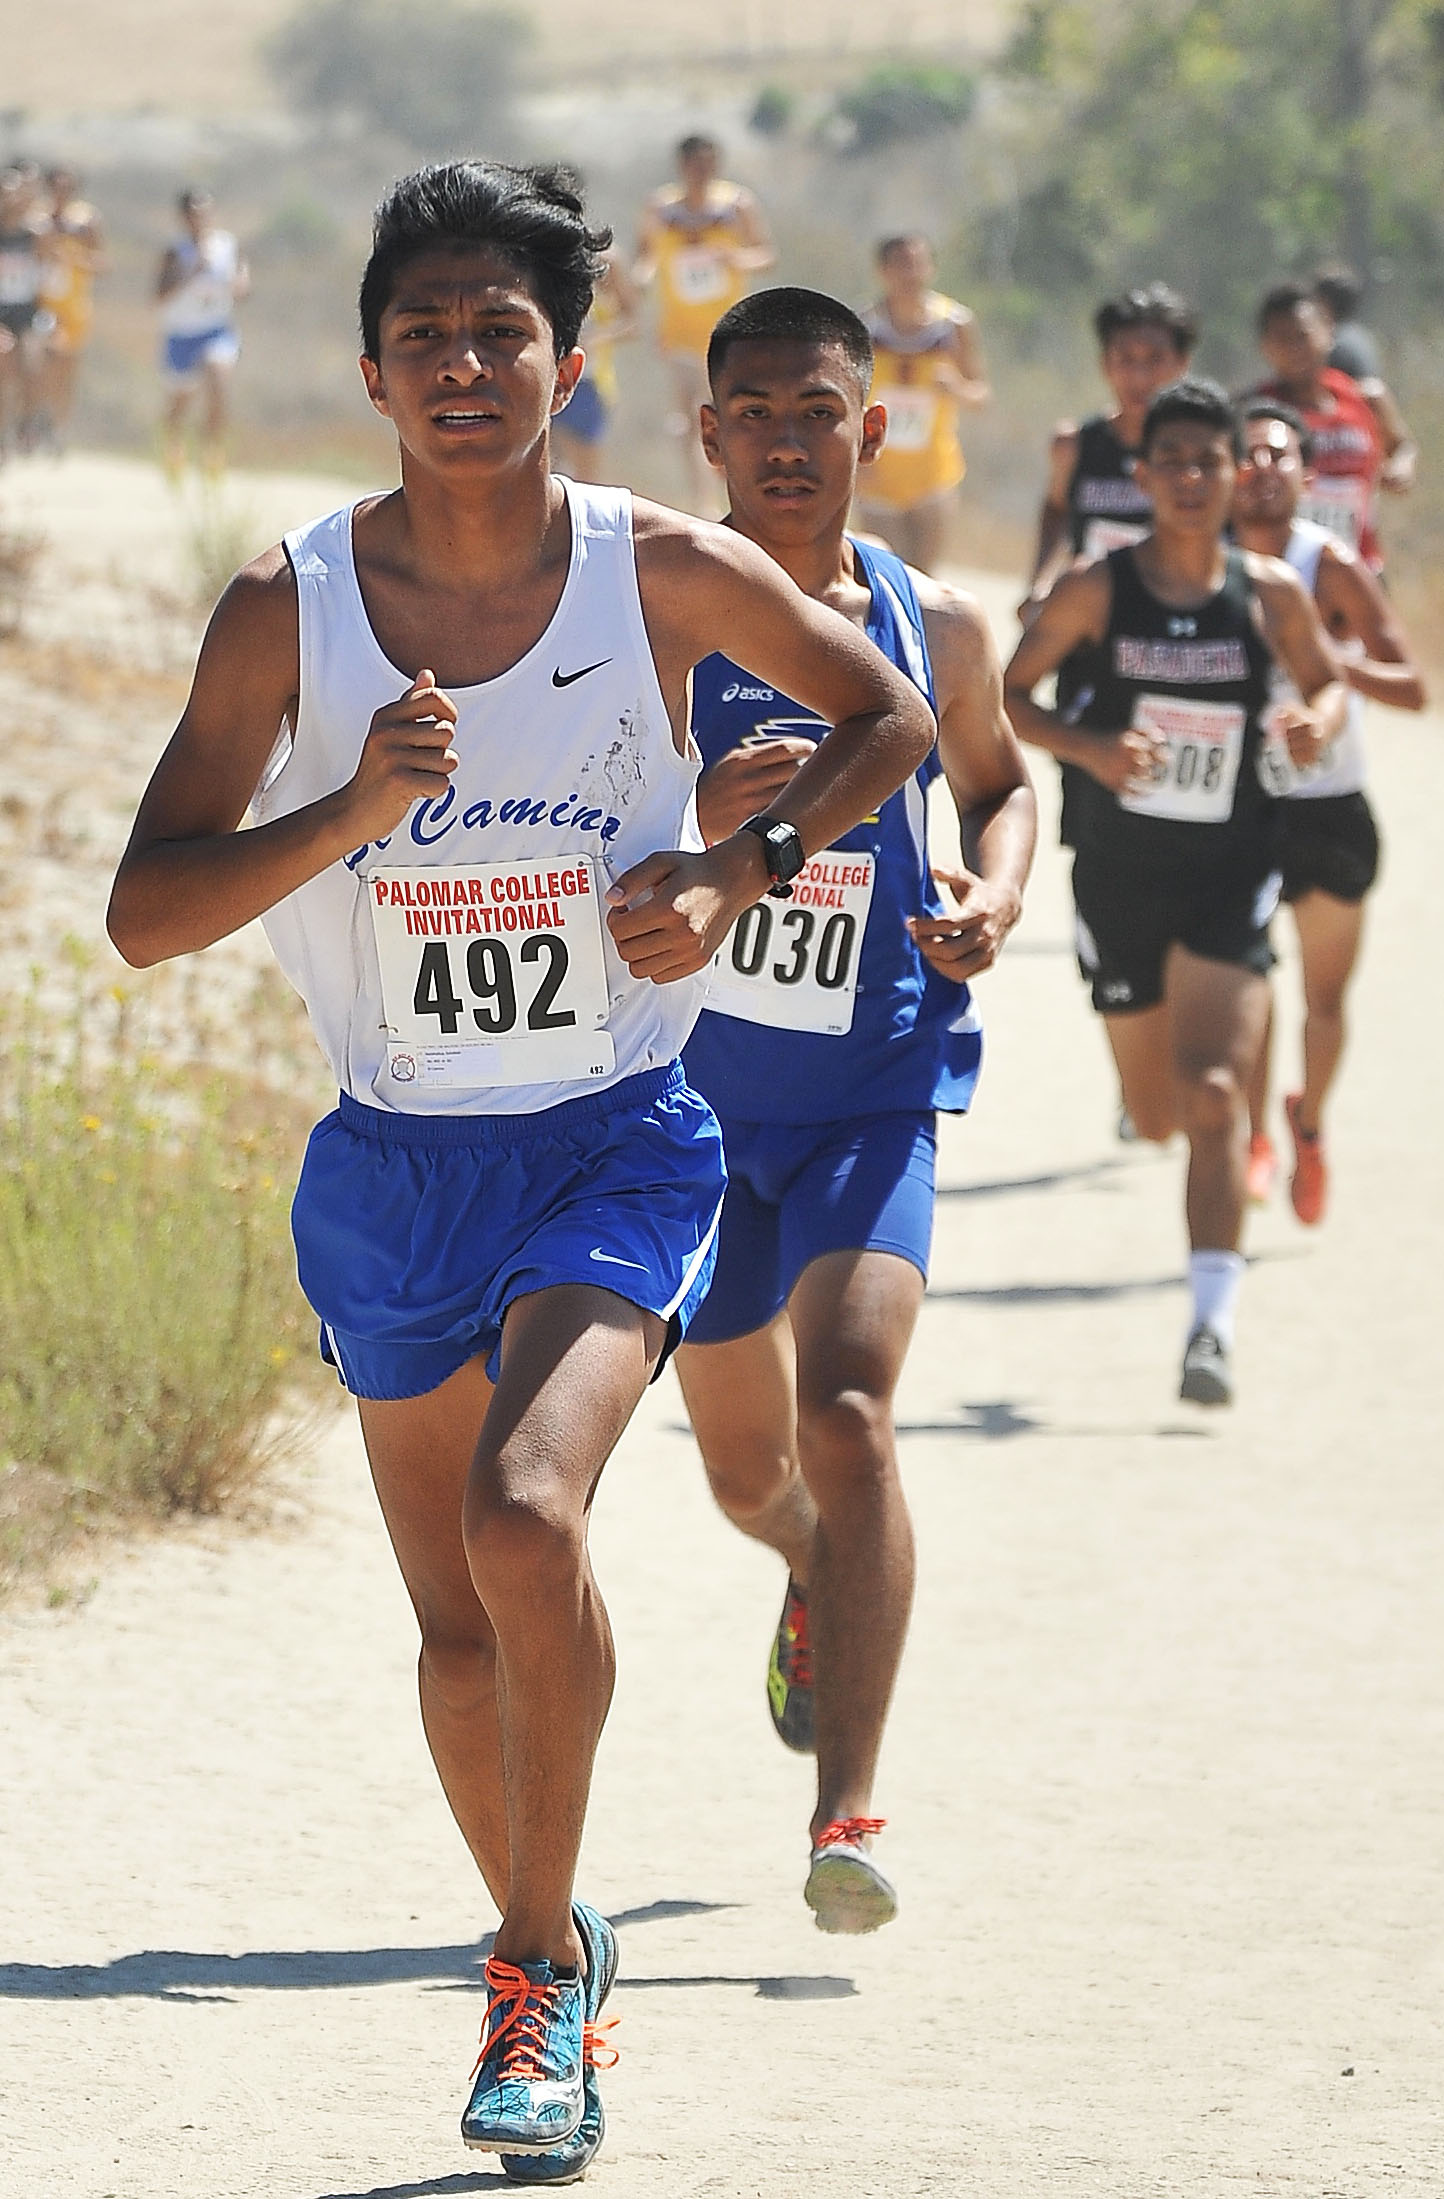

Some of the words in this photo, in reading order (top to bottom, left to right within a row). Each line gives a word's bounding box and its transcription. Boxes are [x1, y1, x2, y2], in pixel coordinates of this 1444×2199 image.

[739, 687, 775, 702] asics
[375, 878, 485, 907] PALOMAR
[490, 868, 590, 902] COLLEGE
[405, 901, 566, 936] INVITATIONAL
[715, 902, 857, 990] 030
[413, 933, 577, 1035] 492
[589, 1065, 604, 1075] 492
